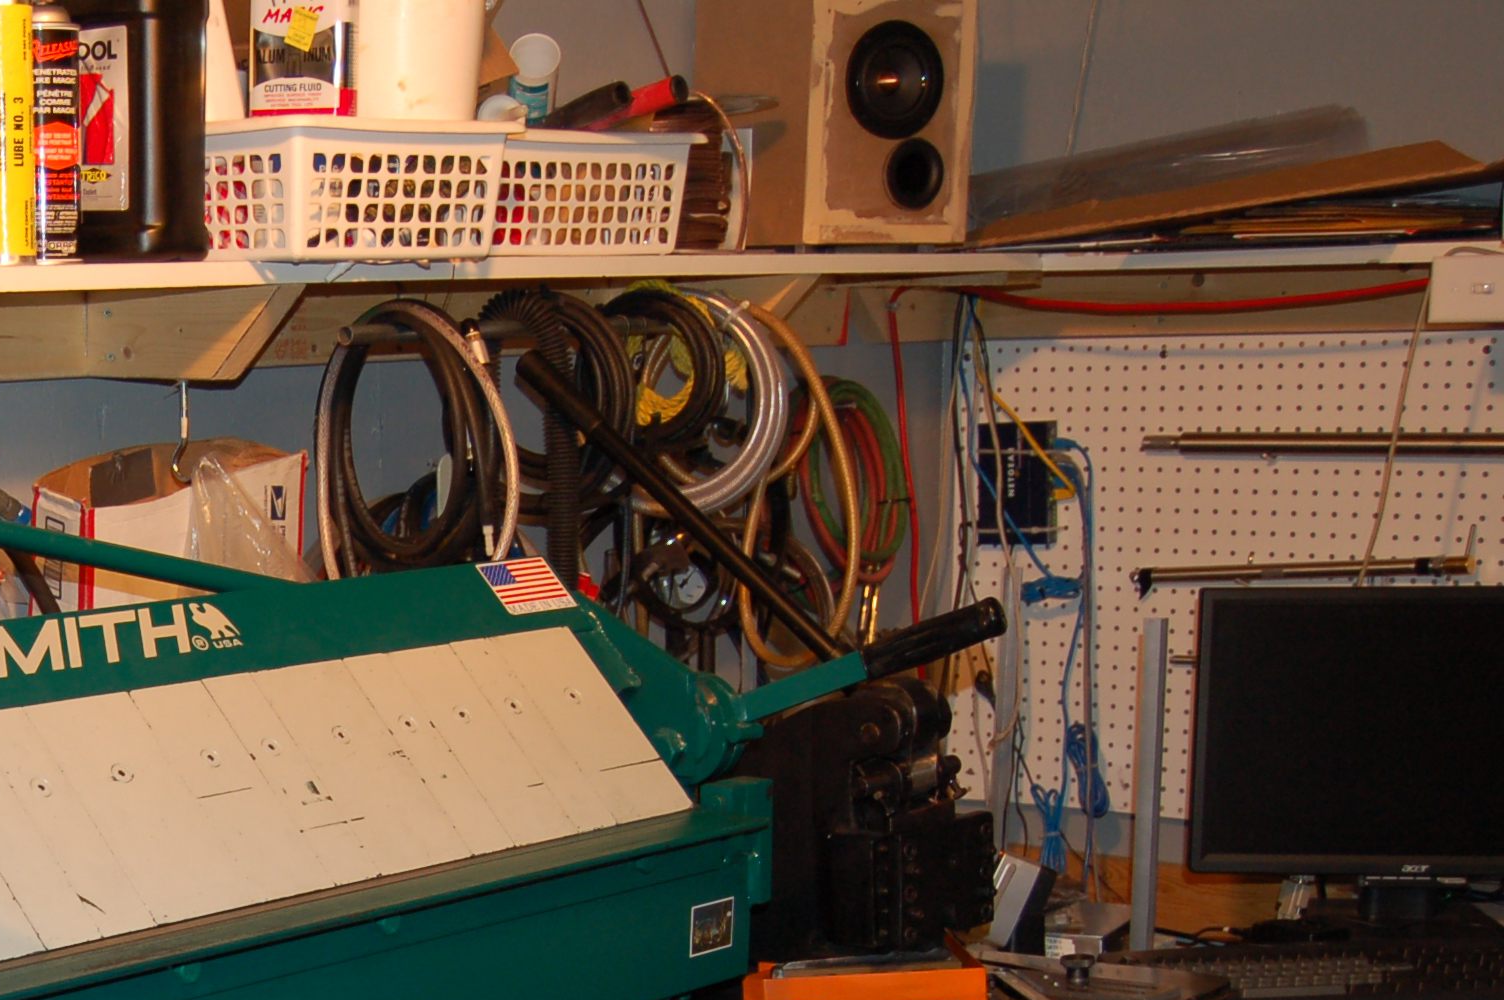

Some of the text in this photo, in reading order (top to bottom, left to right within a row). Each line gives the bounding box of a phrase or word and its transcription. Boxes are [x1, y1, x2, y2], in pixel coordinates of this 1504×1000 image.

[264, 82, 322, 93] CUTTING FLUID
[13, 96, 24, 167] LUBE NO. 3
[212, 638, 243, 648] USA
